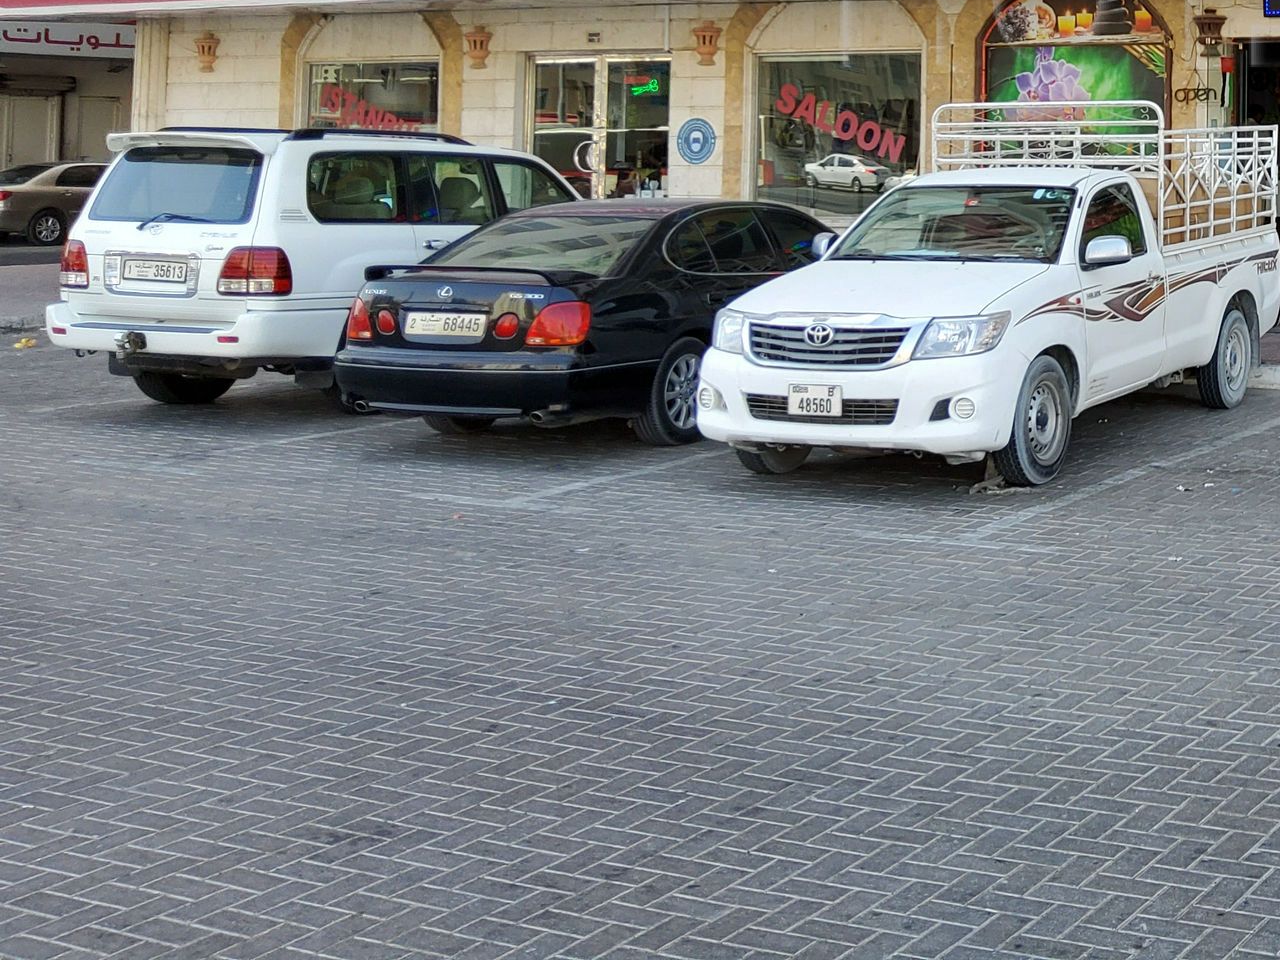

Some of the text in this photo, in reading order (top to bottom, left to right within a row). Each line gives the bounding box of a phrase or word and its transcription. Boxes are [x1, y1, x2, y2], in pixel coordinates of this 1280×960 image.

[1174, 81, 1217, 105] open
[775, 83, 906, 164] SALOON
[153, 264, 184, 279] 35613
[410, 318, 416, 329] 2
[443, 317, 481, 333] 68445
[798, 397, 832, 414] 48560
